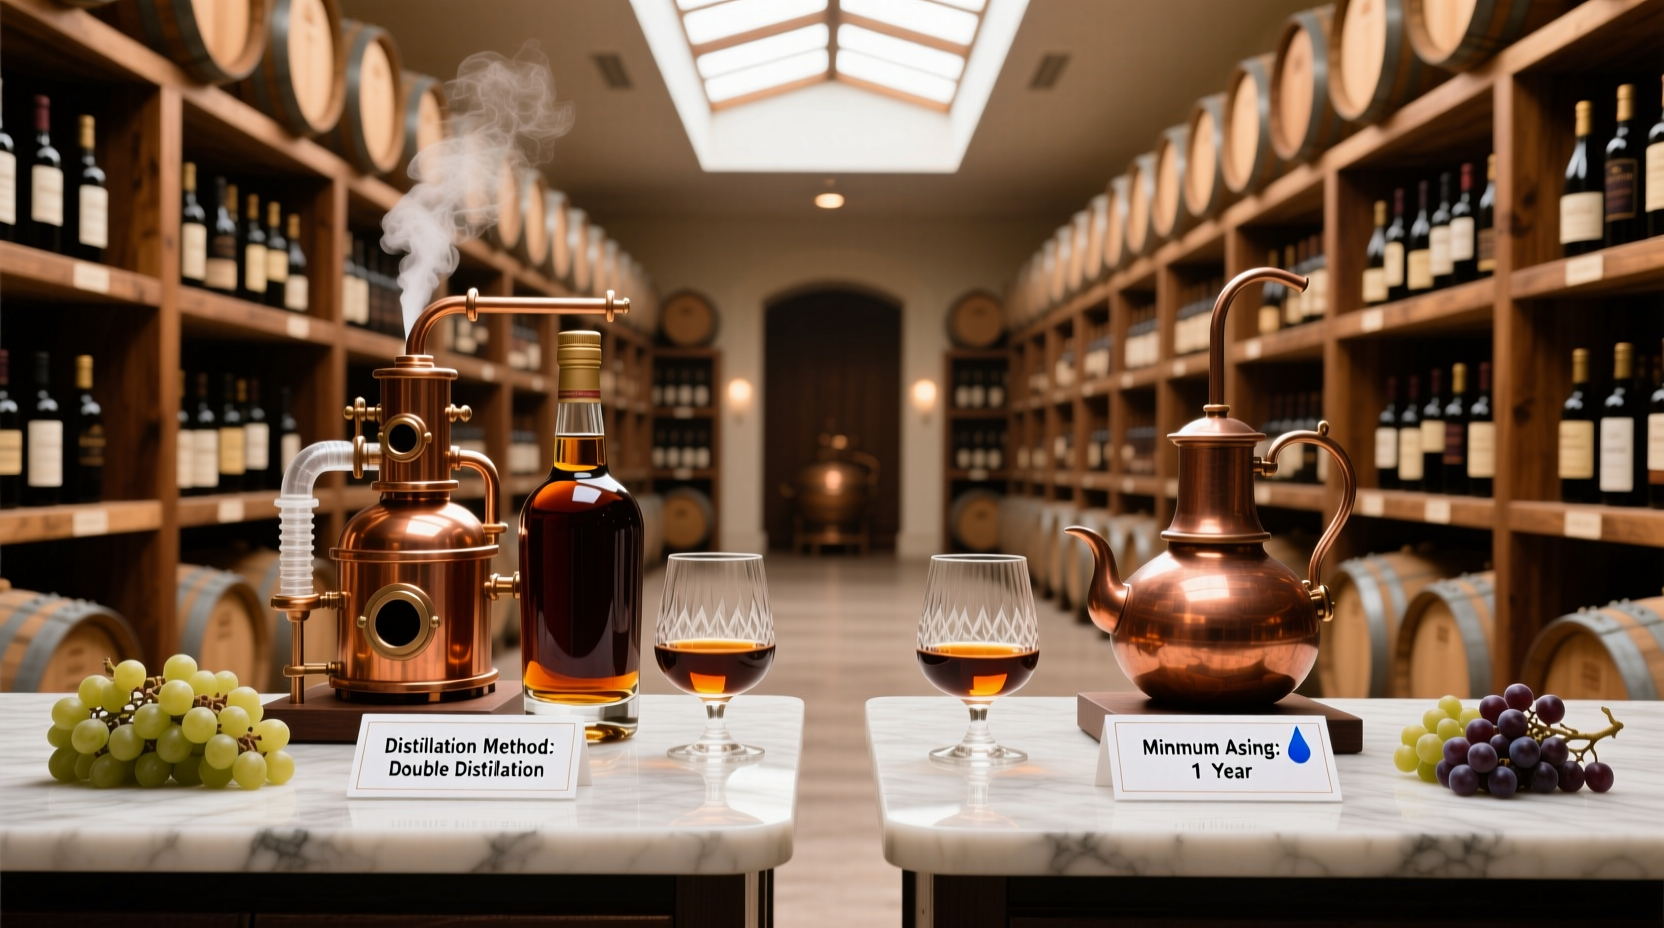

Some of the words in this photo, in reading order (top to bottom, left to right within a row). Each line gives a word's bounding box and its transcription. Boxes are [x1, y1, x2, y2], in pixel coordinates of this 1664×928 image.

[384, 736, 477, 754] Distillation
[483, 737, 555, 755] Method:
[1142, 738, 1220, 756] Minmum
[1224, 738, 1280, 760] Asing:
[388, 759, 450, 777] Double
[454, 759, 544, 778] Distillation
[1191, 762, 1201, 780] 1
[1211, 762, 1253, 780] Year
